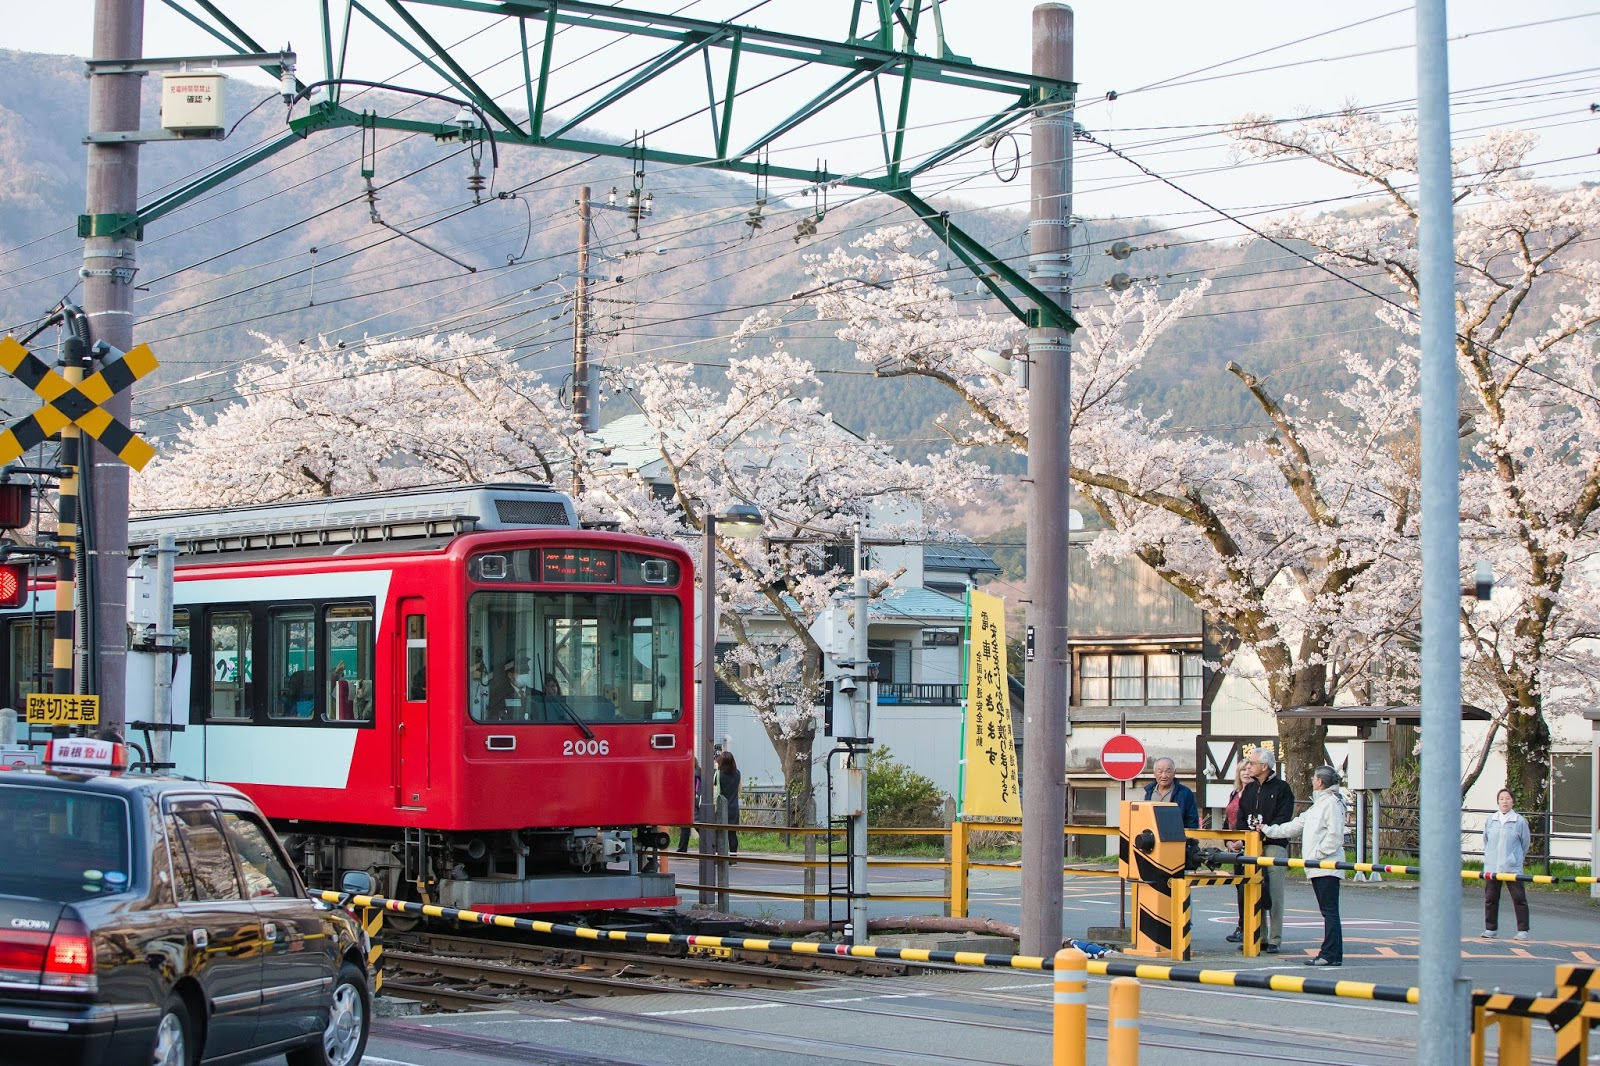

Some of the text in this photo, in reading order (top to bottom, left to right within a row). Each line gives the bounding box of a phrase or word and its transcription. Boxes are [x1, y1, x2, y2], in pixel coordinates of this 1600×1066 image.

[186, 95, 203, 104] 確認
[29, 697, 97, 721] 踏切注意
[58, 746, 108, 760] 箱根登山
[562, 740, 610, 756] 2006
[11, 918, 50, 929] CROWN
